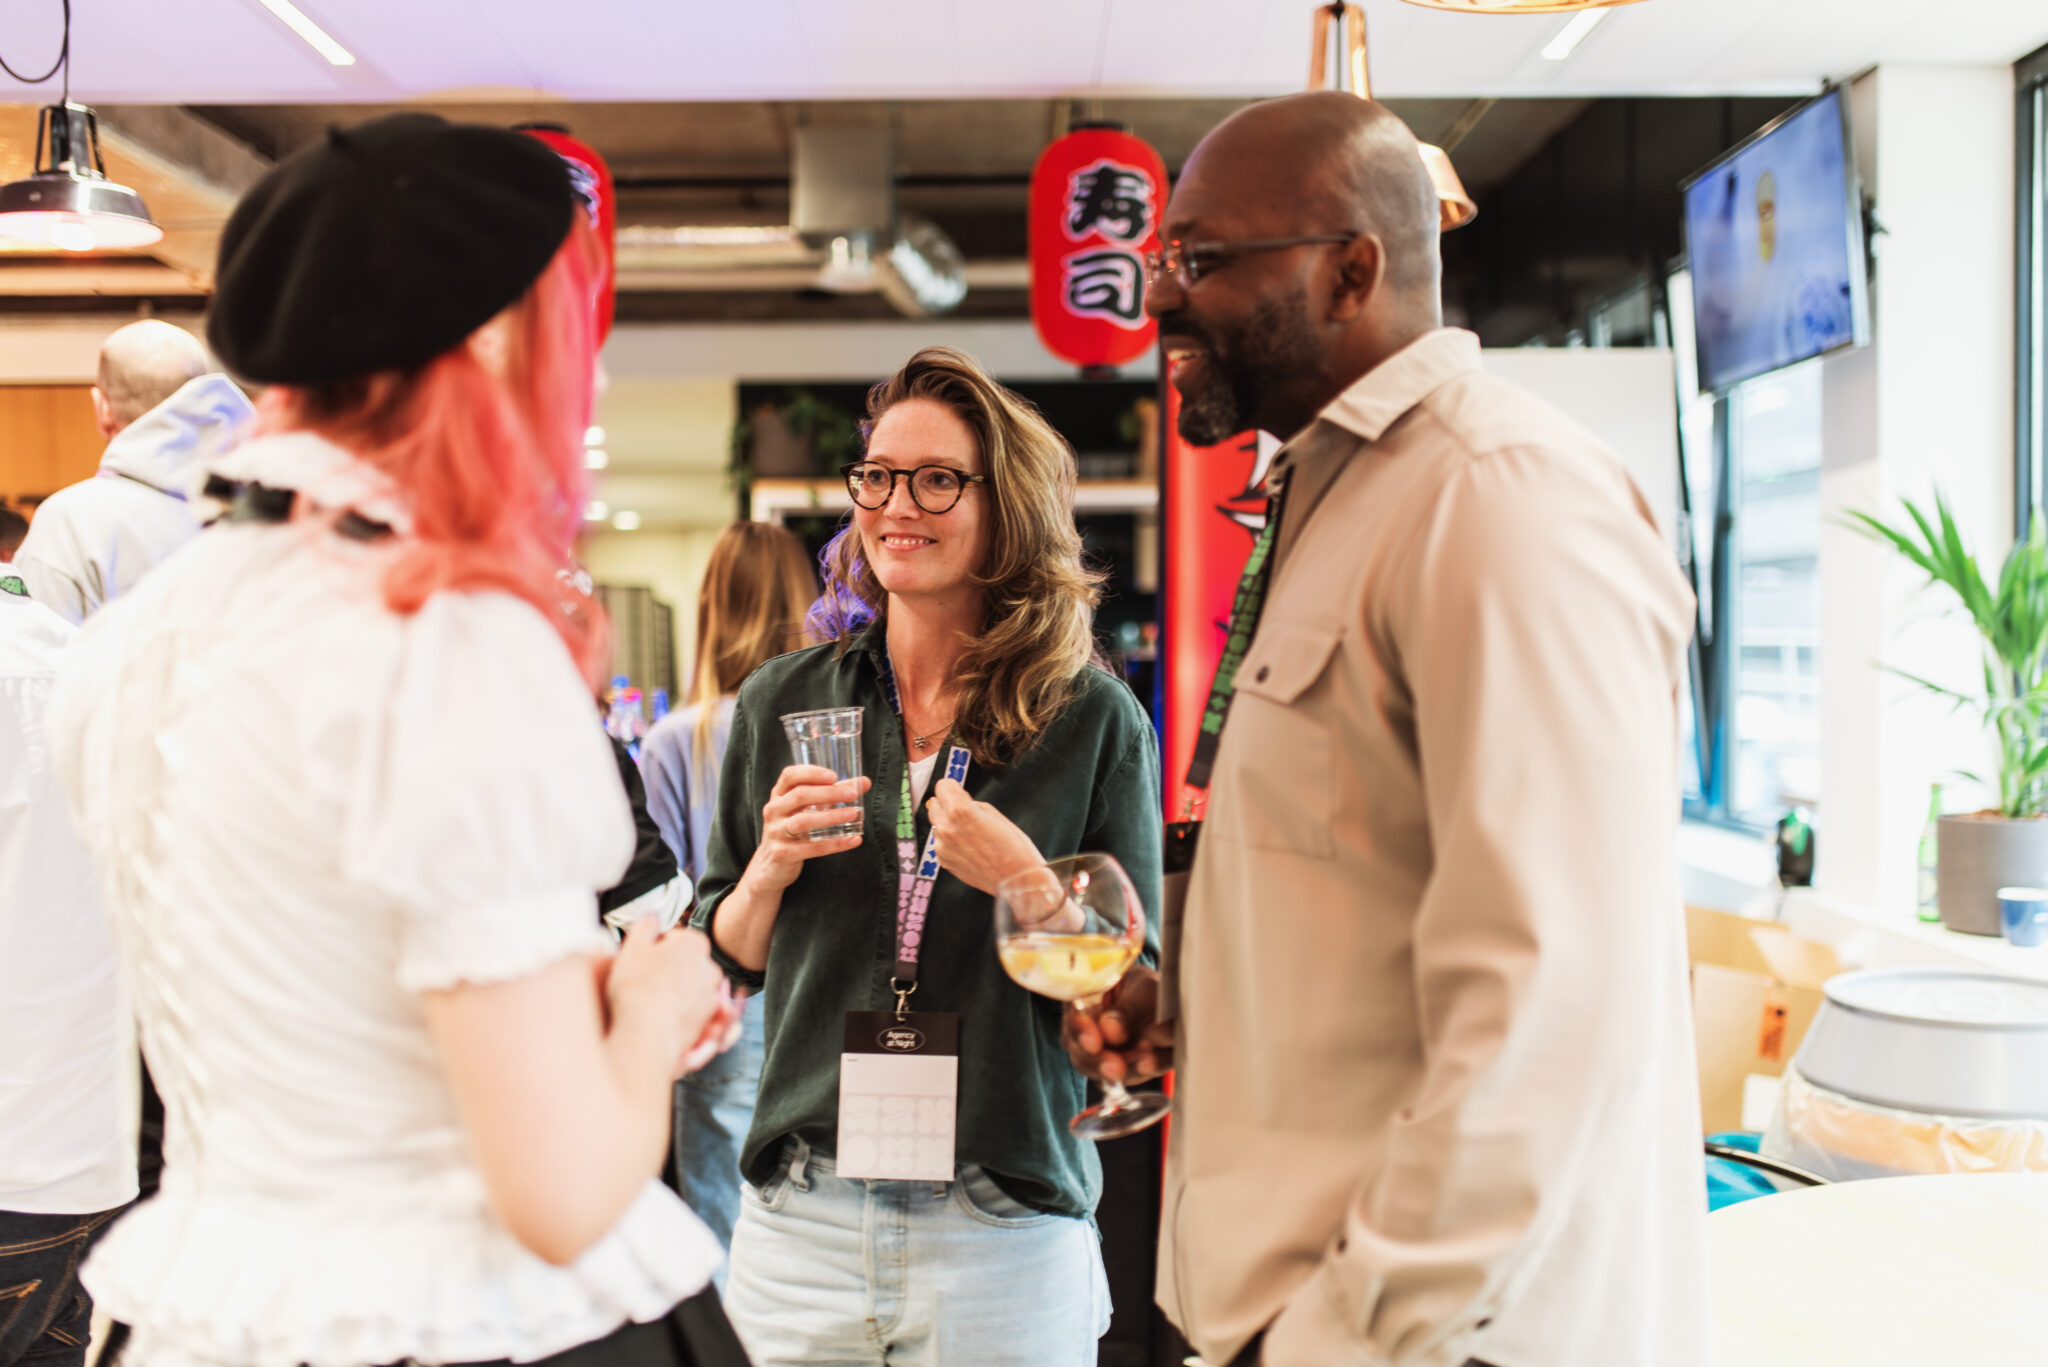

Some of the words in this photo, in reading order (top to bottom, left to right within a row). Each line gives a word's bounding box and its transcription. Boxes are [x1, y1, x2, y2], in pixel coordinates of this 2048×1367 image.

[1066, 163, 1150, 324] 寿司
[887, 1031, 916, 1040] Agency
[896, 1040, 915, 1048] Night
